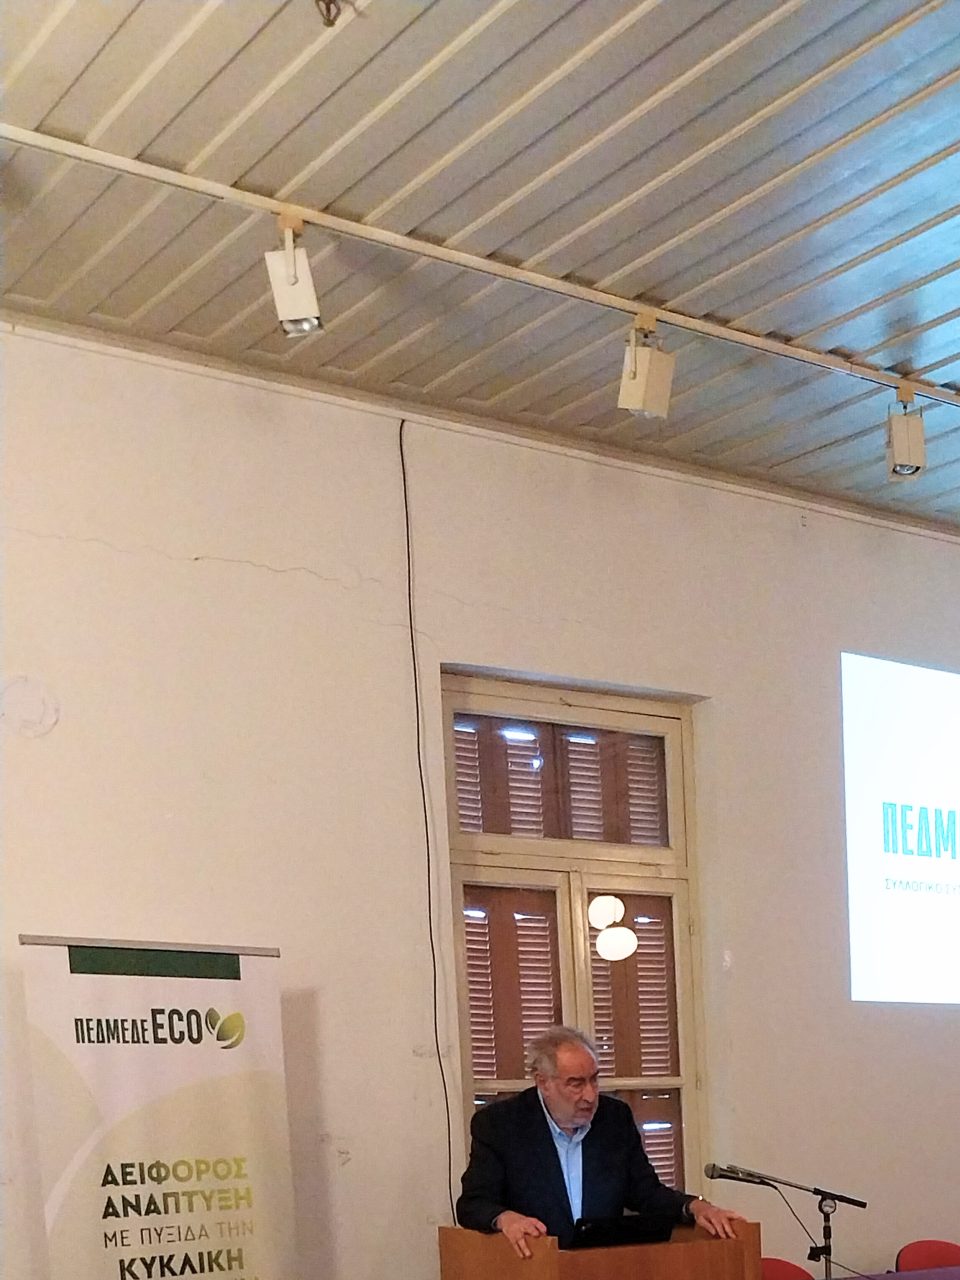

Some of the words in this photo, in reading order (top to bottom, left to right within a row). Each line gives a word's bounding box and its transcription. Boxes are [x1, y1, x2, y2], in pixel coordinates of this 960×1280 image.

[101, 1157, 248, 1187] ΑΕΙΦΟΡΟΣ
[102, 1186, 254, 1220] ΑΝΑΠΤΥΞΗ
[103, 1229, 131, 1249] ΜΕ
[140, 1223, 210, 1245] ΠΥΞΙΔΑ
[216, 1220, 255, 1239] ΤΗΝ
